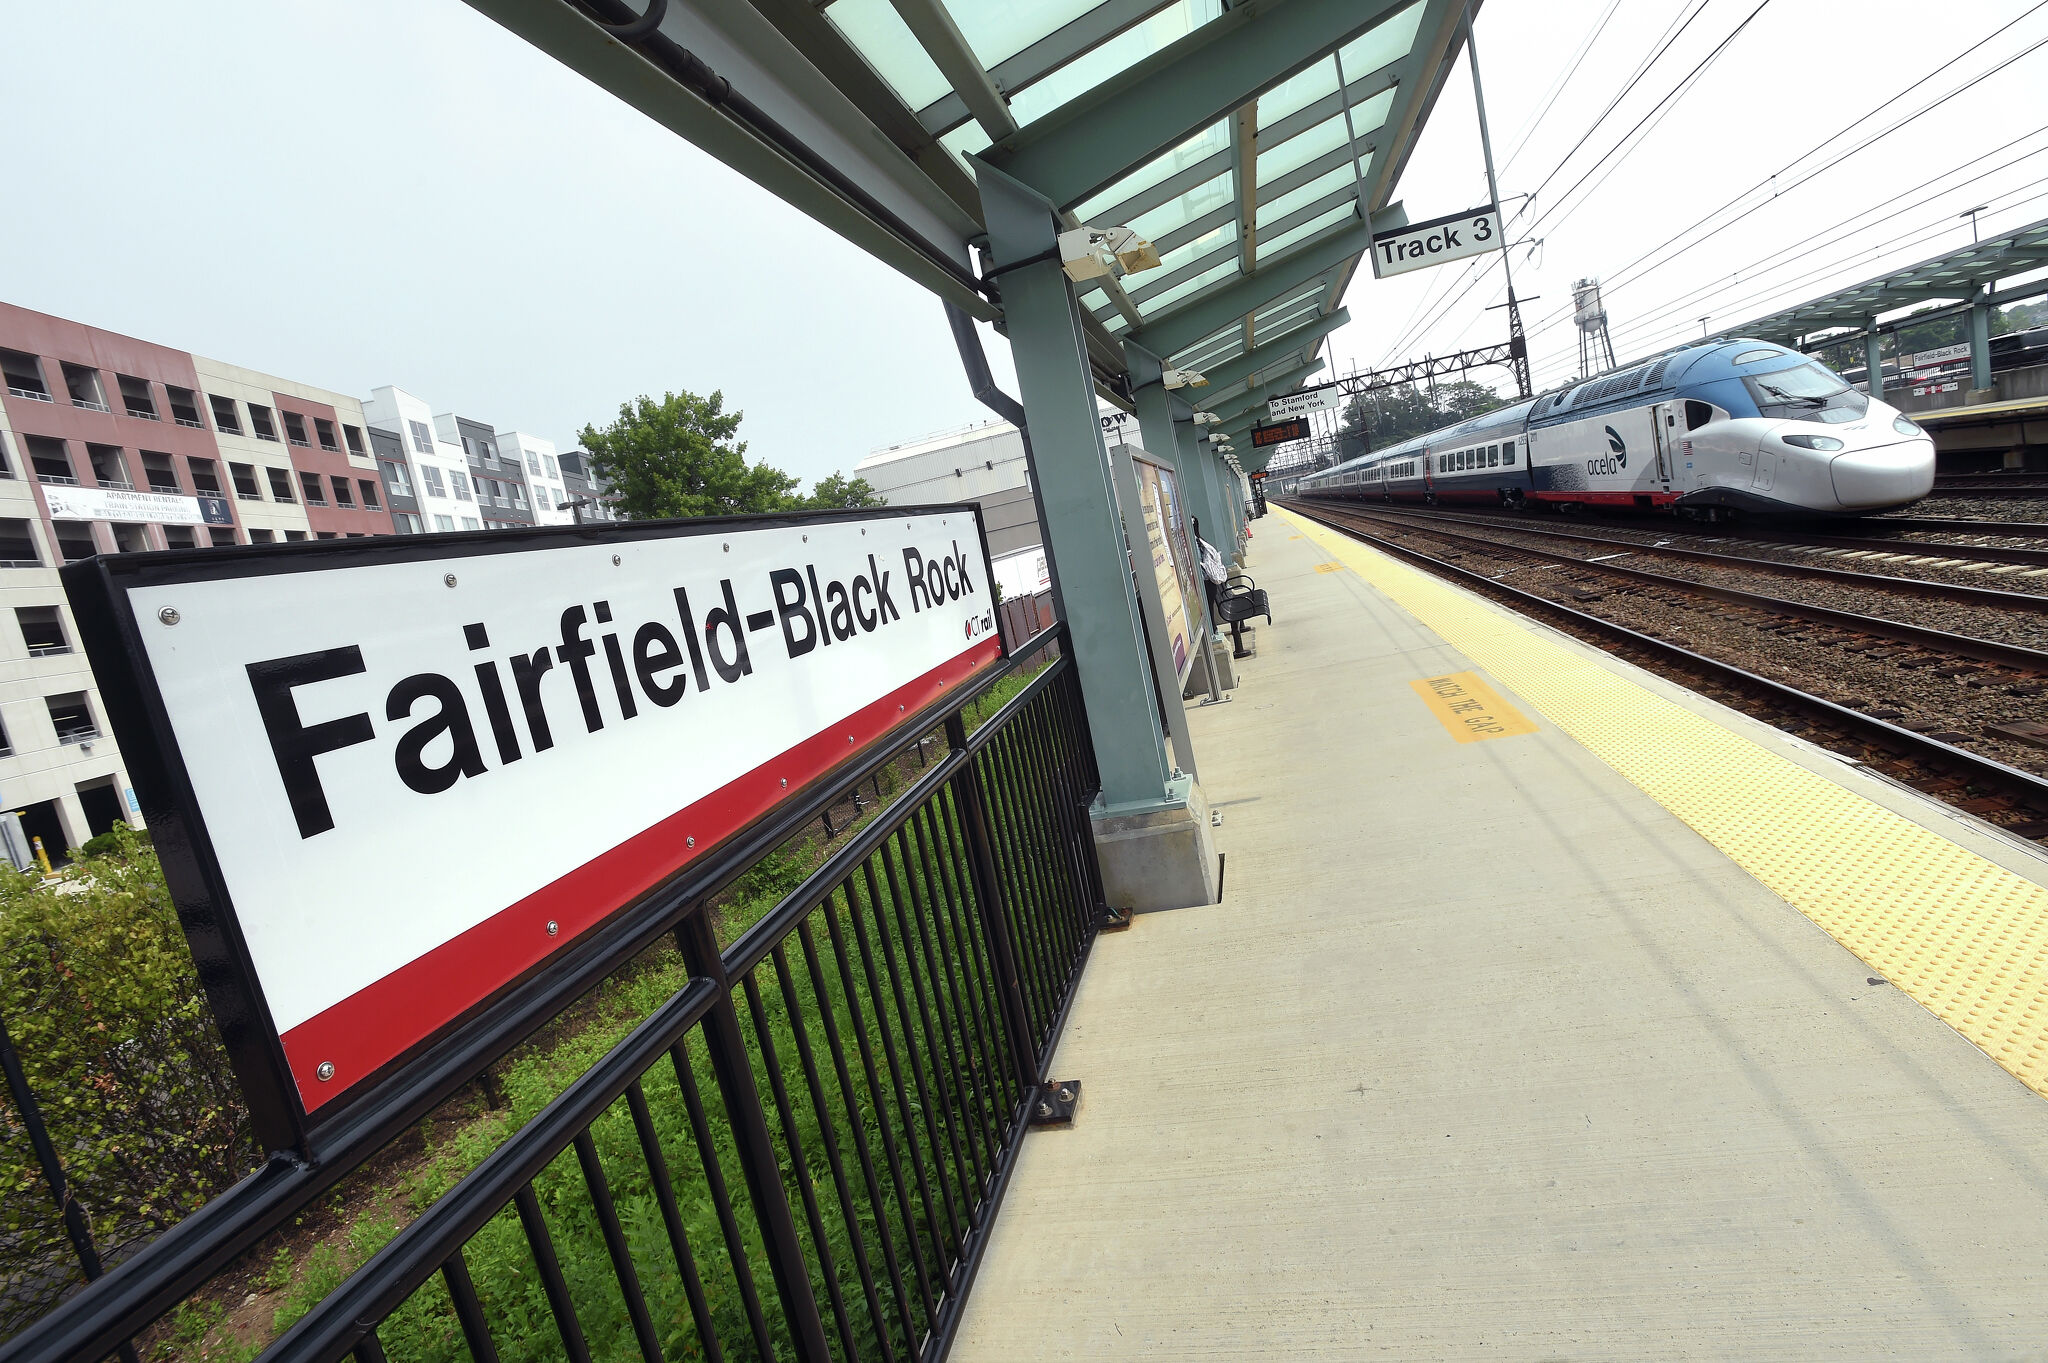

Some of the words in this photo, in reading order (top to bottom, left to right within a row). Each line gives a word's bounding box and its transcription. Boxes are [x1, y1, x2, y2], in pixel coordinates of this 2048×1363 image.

[1378, 227, 1462, 264] Track
[1472, 217, 1492, 241] 3
[1915, 350, 1952, 362] Fairfield-Black
[1281, 392, 1318, 406] Stamford
[1271, 408, 1286, 417] and
[1288, 404, 1305, 413] New
[1307, 399, 1325, 408] York
[1588, 451, 1617, 476] acela
[106, 492, 152, 502] APARTMENT
[245, 553, 900, 840] Fairfield-Black
[902, 540, 974, 613] Rock
[1427, 678, 1468, 699] WATCH
[1447, 698, 1485, 714] THE
[1464, 716, 1505, 733] GAP
